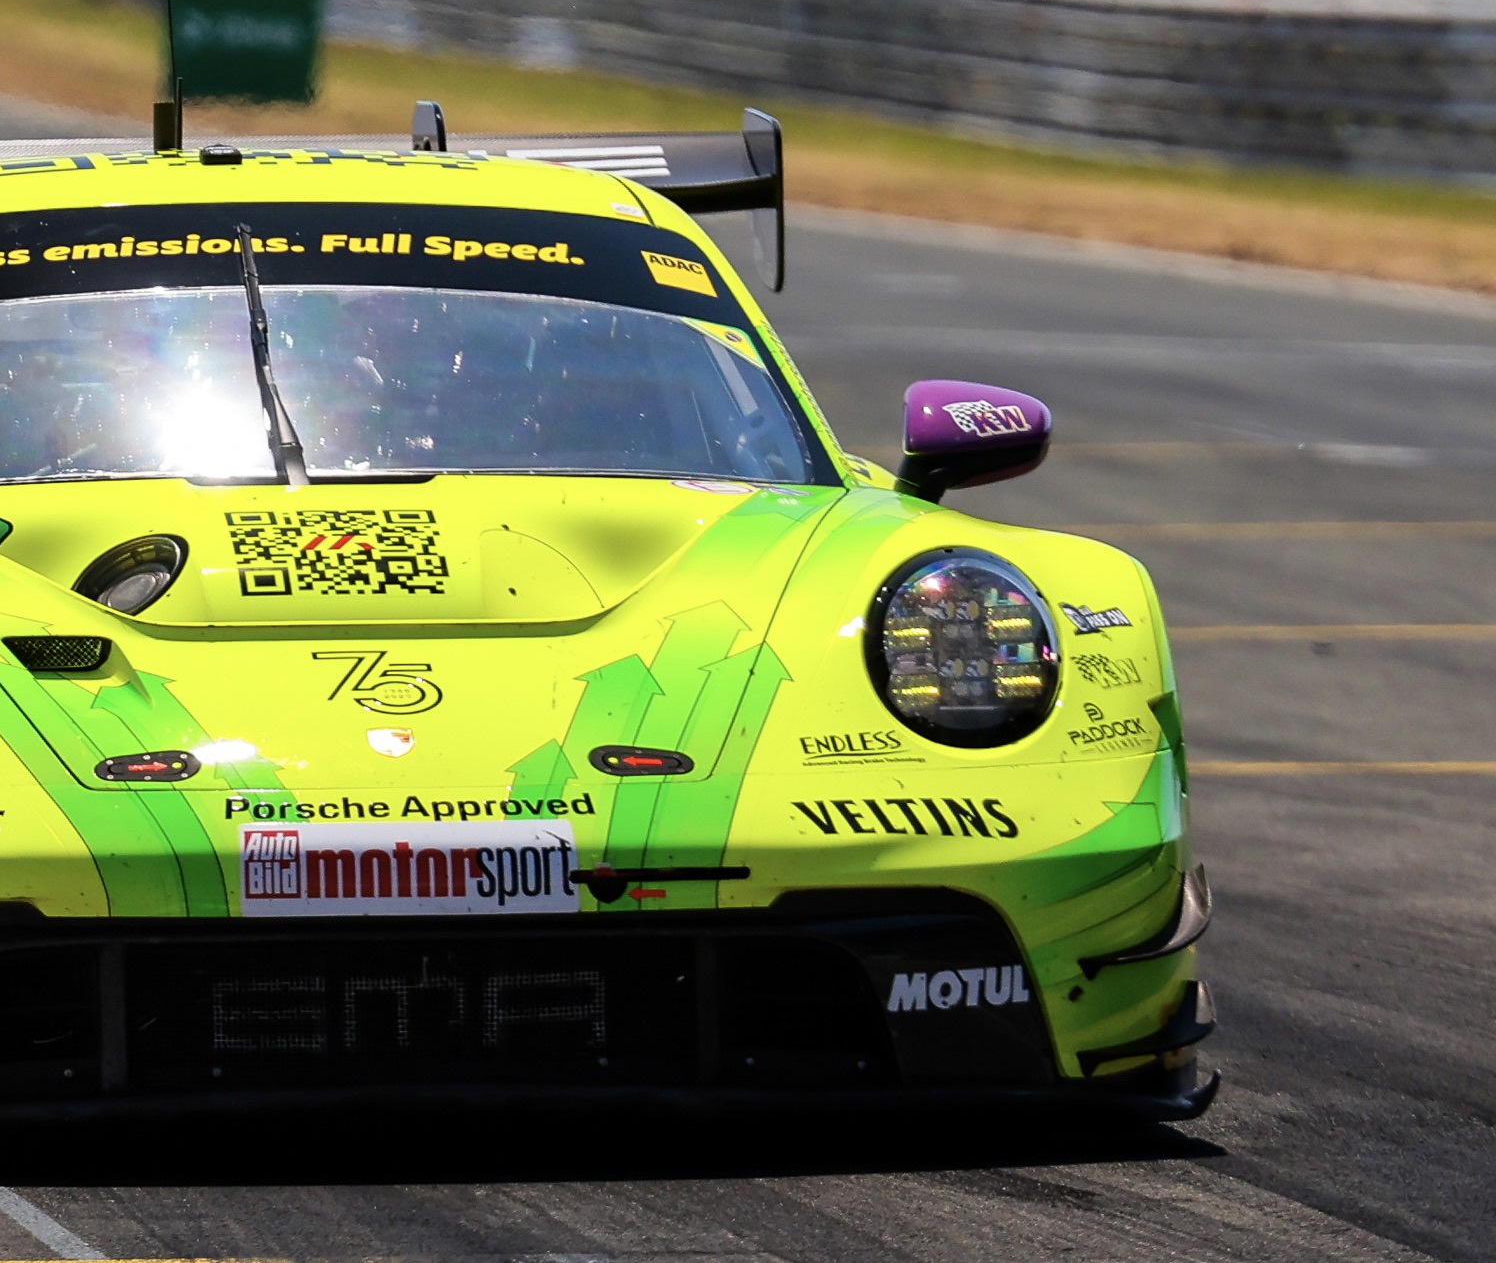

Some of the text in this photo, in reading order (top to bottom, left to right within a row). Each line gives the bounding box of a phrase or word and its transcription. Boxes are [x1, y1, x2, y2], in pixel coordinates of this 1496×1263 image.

[43, 232, 306, 262] emissions.
[320, 233, 411, 255] Full
[423, 235, 586, 267] Speed.
[649, 254, 703, 275] ADAC
[311, 650, 443, 716] 75
[799, 729, 902, 755] ENDLESS
[1067, 718, 1147, 746] PADDOCK
[223, 792, 597, 822] Porsche Approved
[791, 798, 1020, 838] VELTINS
[244, 830, 299, 861] Auto
[246, 862, 300, 896] Bild
[887, 964, 1030, 1013] MOTUL
